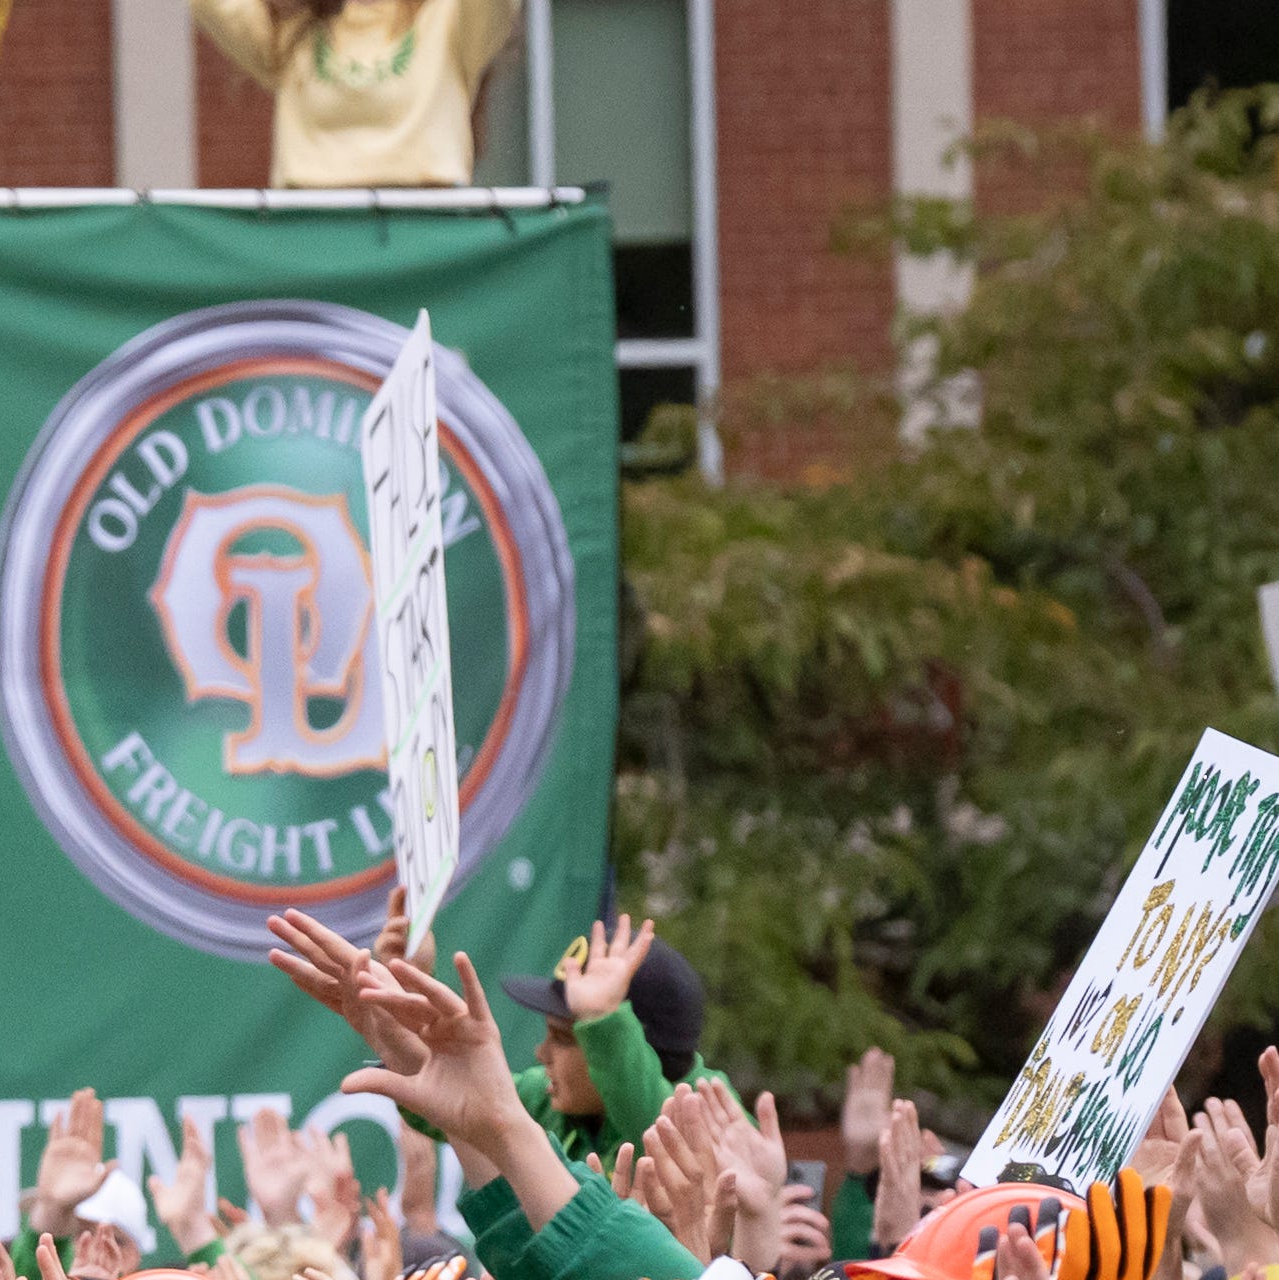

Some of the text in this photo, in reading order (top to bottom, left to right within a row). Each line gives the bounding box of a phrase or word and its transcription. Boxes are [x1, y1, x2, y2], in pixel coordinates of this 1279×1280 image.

[87, 429, 189, 553] OLD
[100, 730, 339, 878] FREIGHT
[1117, 878, 1176, 973] TO
